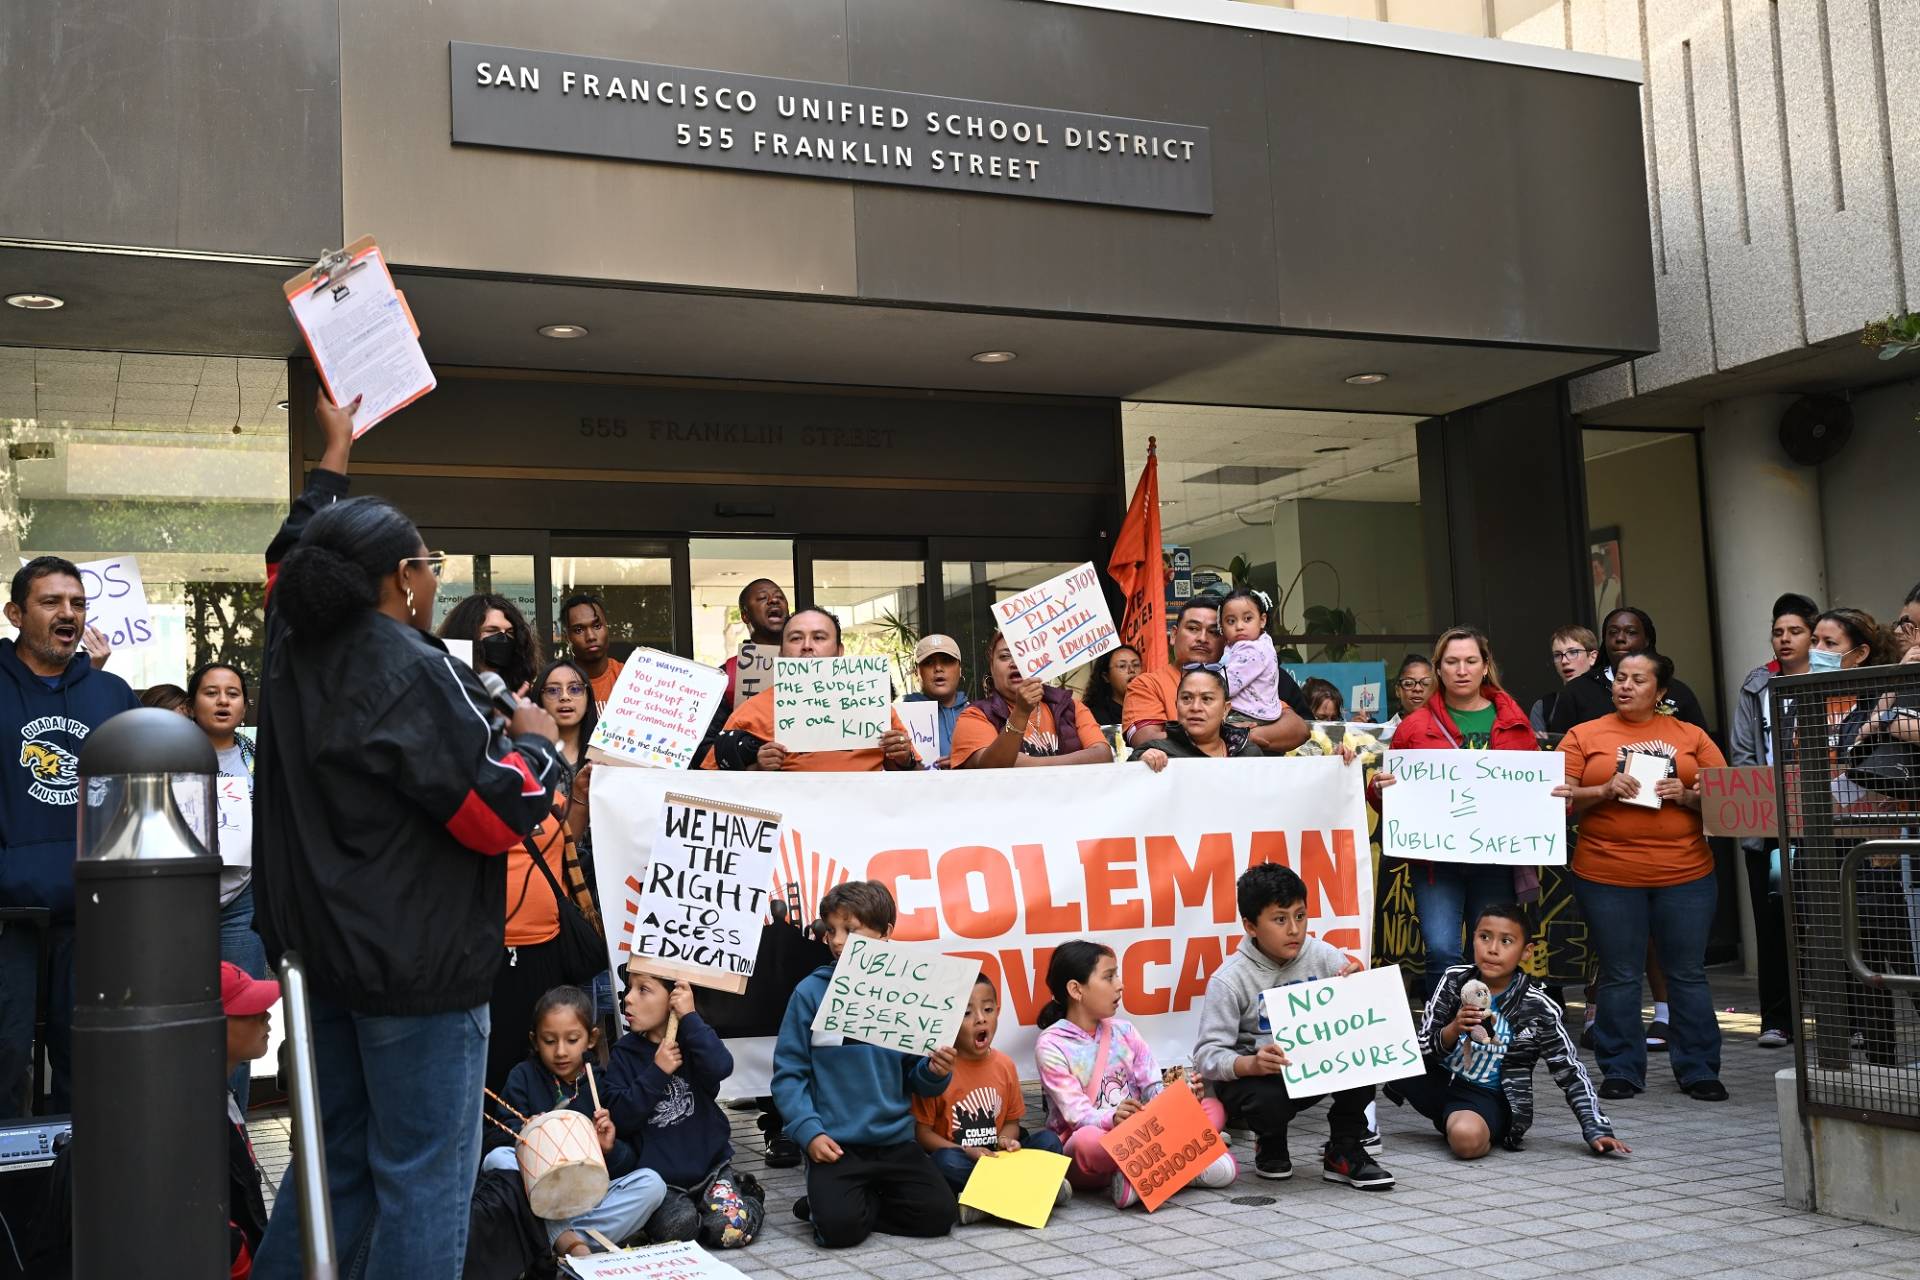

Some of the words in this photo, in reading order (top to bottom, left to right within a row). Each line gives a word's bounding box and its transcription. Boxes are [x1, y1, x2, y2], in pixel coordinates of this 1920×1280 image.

[476, 62, 541, 90] SAN
[562, 71, 757, 112] FRANCISCO
[778, 95, 909, 128] UNIFIED
[927, 111, 1049, 145] SCHOOL
[1065, 127, 1196, 161] DISTRICT
[676, 123, 735, 150] 555
[754, 131, 913, 168] FRANKLIN
[931, 150, 1041, 182] STREET
[579, 417, 627, 438] 555
[648, 420, 784, 444] FRANKLIN
[800, 427, 897, 448] STREET
[1001, 588, 1047, 620] DON'T
[1065, 567, 1096, 596] STOP
[1024, 595, 1071, 631] PLAY
[1013, 630, 1048, 657] STOP
[1052, 609, 1093, 636] WITH
[1027, 652, 1053, 673] OUR
[1058, 622, 1115, 660] EDUCATION
[1088, 639, 1111, 658] STOP
[777, 660, 823, 677] DON'T
[832, 657, 888, 677] BALANCE
[775, 682, 803, 693] THE
[814, 679, 878, 695] BUDGET
[777, 700, 797, 708] ON
[803, 698, 830, 708] THE
[839, 695, 886, 710] BACKS
[778, 717, 795, 730] OF
[805, 715, 835, 727] OUR
[842, 720, 886, 740] KIDS
[1389, 755, 1461, 782] PUBLIC
[1476, 757, 1552, 783] SCHOOL
[28, 782, 79, 805] MUSTAN
[1450, 787, 1477, 804] IS
[665, 806, 707, 842] WE
[711, 812, 779, 853] HAVE
[1720, 800, 1778, 832] OUR
[1388, 819, 1457, 850] PUBLIC
[1469, 828, 1556, 857] SAFETY
[683, 844, 742, 876] THE
[649, 862, 767, 914] RIGHT
[642, 911, 742, 945] ACCESS
[678, 903, 720, 926] TO
[637, 934, 755, 975] EDUCATION
[848, 940, 929, 981] PUBLIC
[834, 976, 956, 1011] SCHOOLS
[1287, 986, 1335, 1018] NO
[831, 998, 944, 1034] DESERVE
[1275, 1008, 1387, 1052] SCHOOL
[824, 1016, 938, 1053] BETTER
[1284, 1039, 1418, 1084] CLOSURES
[1112, 1116, 1165, 1161] SAVE
[1125, 1142, 1166, 1178] OUR
[1137, 1128, 1218, 1197] SCHOOLS
